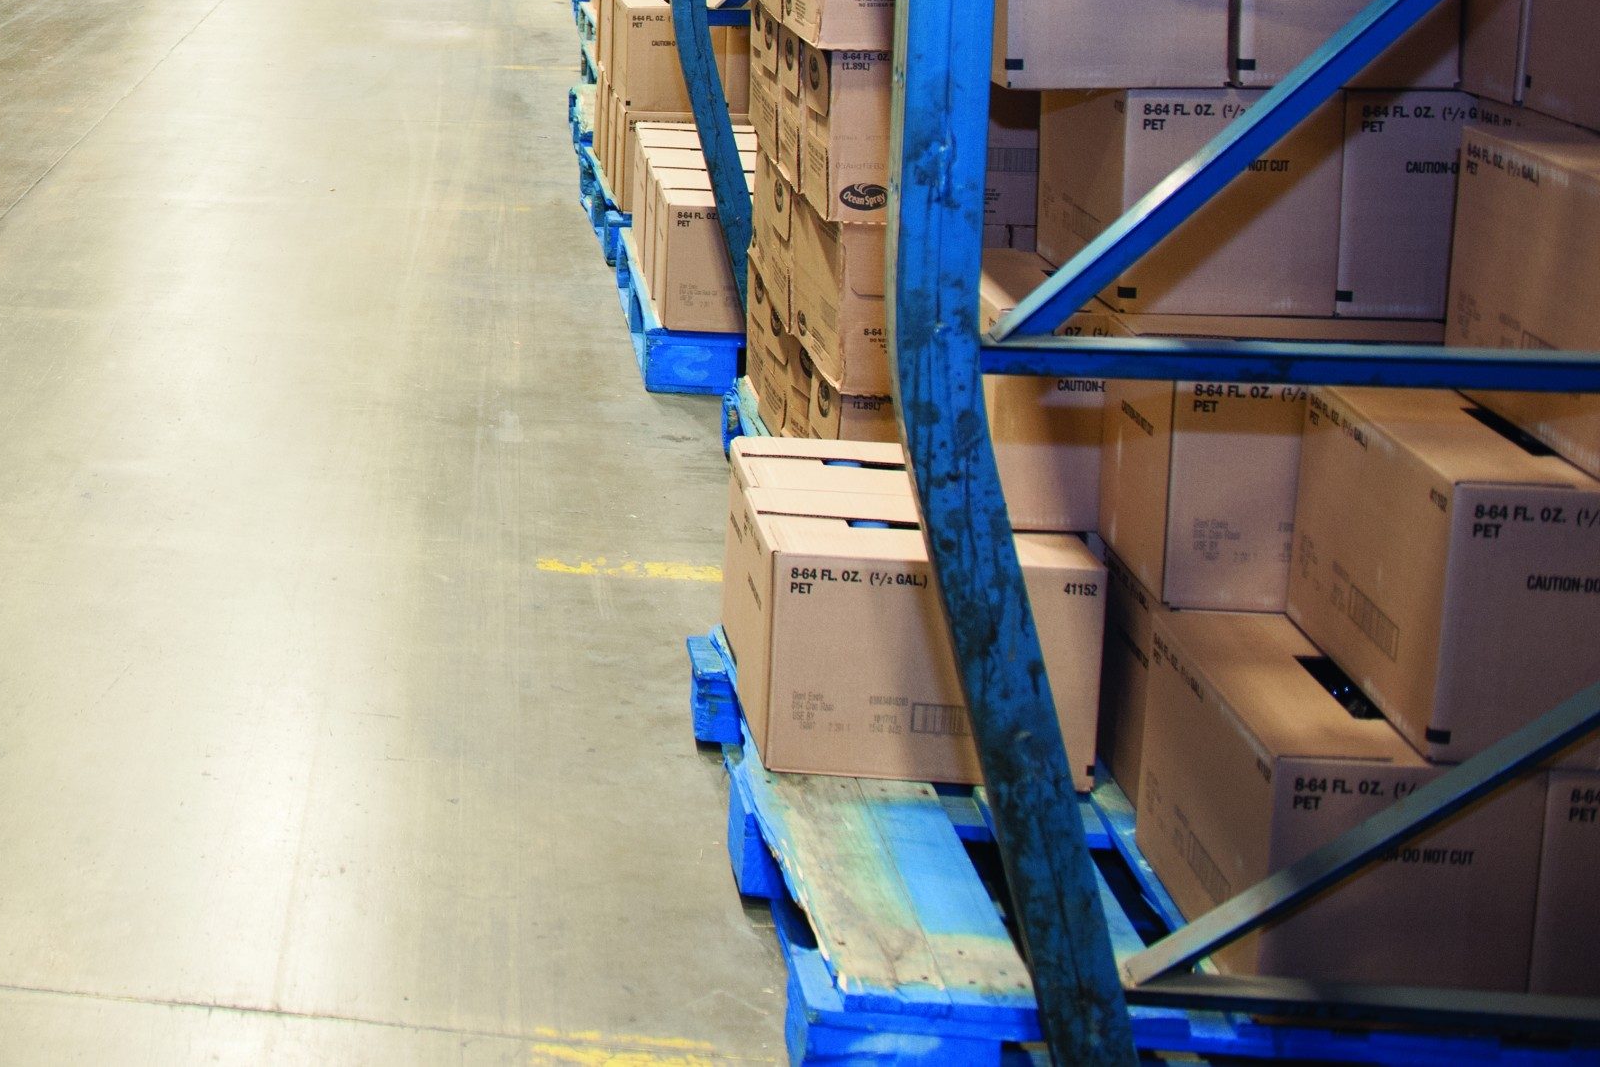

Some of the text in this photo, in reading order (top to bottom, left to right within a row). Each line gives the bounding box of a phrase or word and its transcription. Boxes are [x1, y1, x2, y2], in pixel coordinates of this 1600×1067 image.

[841, 52, 890, 61] 8-64 FL. OZ.
[841, 62, 870, 70] (1.89L)
[1143, 103, 1215, 117] 8-64 FL. OZ.
[1362, 105, 1389, 118] 8-64
[1392, 106, 1409, 118] FL.
[1413, 106, 1435, 119] OZ.
[1143, 118, 1166, 131] PET
[1361, 121, 1385, 133] PET
[1248, 160, 1290, 172] NOT CUT
[1466, 160, 1478, 176] PET
[843, 190, 886, 207] Ocean Spray
[677, 212, 693, 220] 8-64
[694, 212, 704, 220] FL.
[1193, 384, 1223, 398] 8-64
[1227, 385, 1245, 399] FL.
[1250, 386, 1273, 399] OZ.
[1193, 400, 1219, 413] PET
[1309, 410, 1320, 427] PET
[1474, 504, 1566, 523] 8-64 FL. OZ.
[1473, 523, 1502, 538] PET
[790, 567, 818, 581] 8-64
[821, 568, 838, 582] FL.
[841, 569, 862, 583] OZ.
[895, 573, 928, 589] GAL.)
[790, 582, 813, 594] PET
[1063, 582, 1098, 597] 41152
[1294, 777, 1384, 796] 8-64 FL. OZ.
[1292, 795, 1321, 810] PET
[1568, 806, 1599, 823] PET
[1423, 848, 1475, 865] NOT CUT
